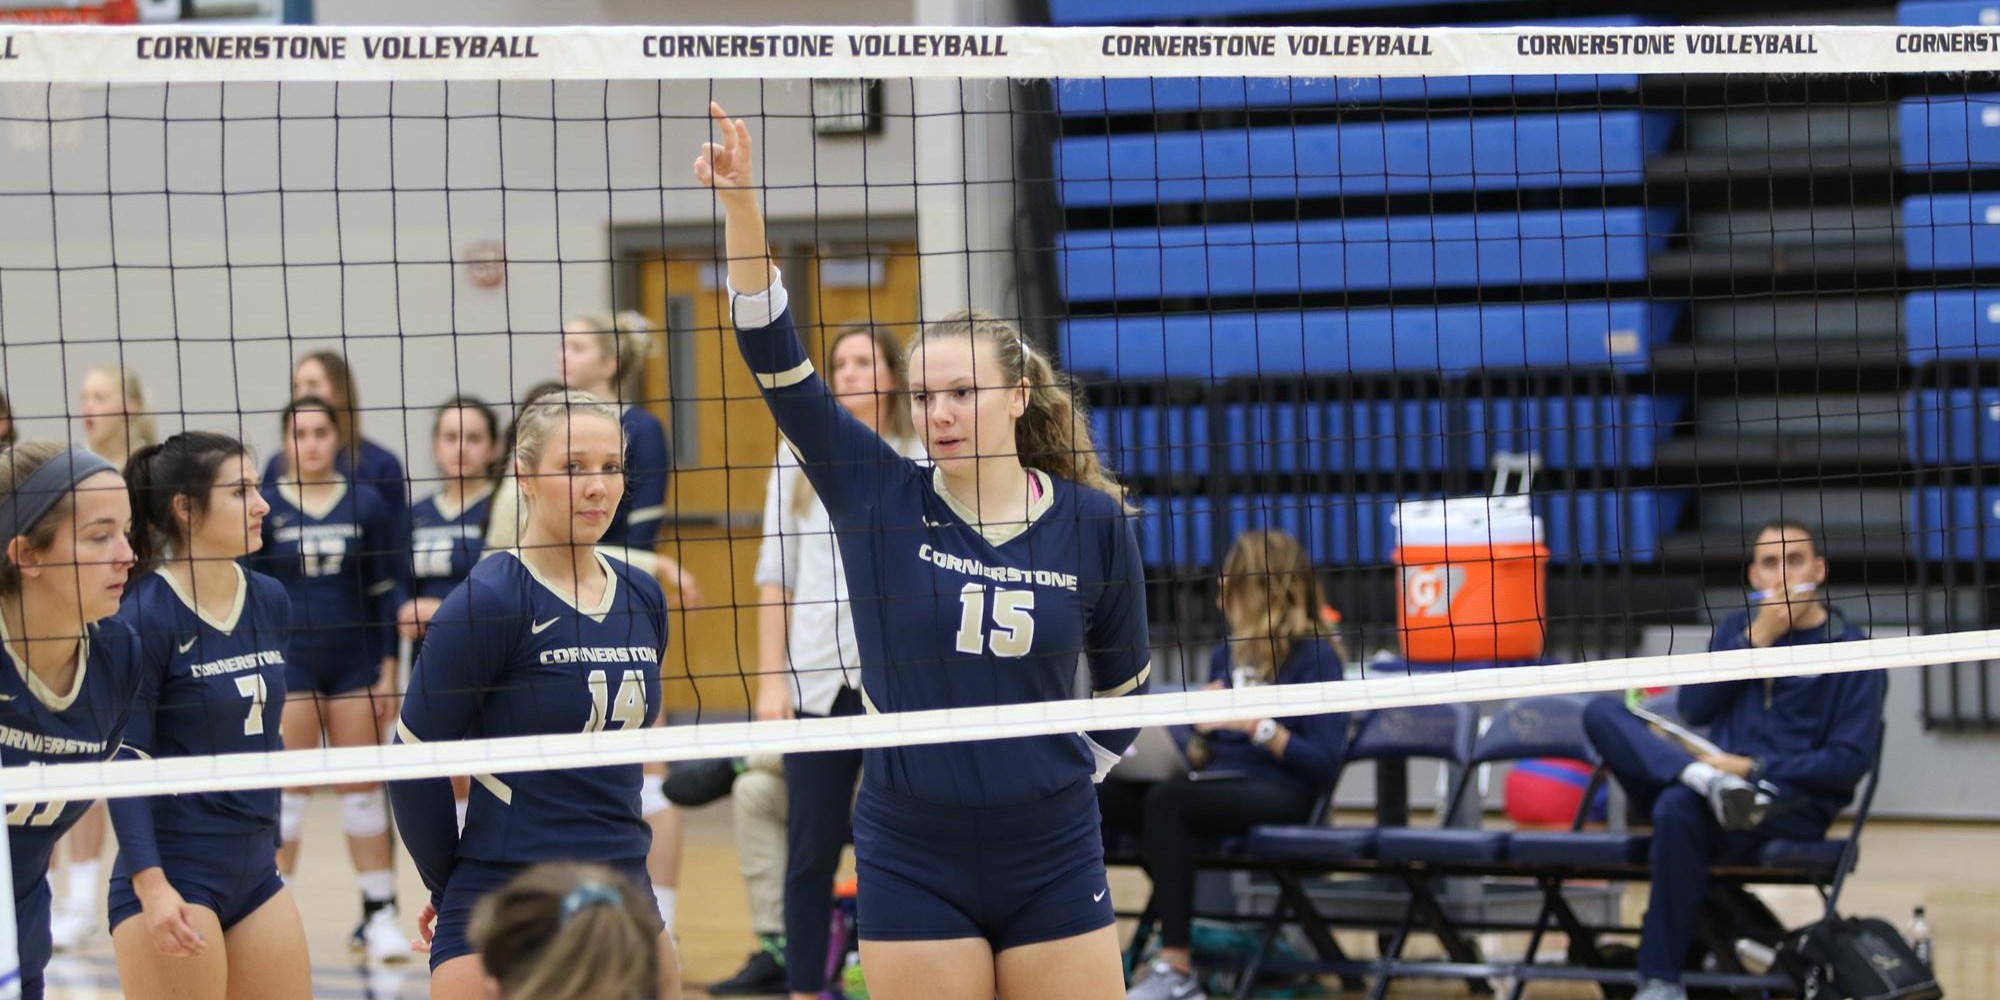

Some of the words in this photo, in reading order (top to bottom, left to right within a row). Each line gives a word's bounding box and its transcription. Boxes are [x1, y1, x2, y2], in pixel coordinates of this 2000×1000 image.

[136, 36, 347, 60] CORNERSTONE
[362, 35, 539, 60] VOLLEYBALL
[642, 35, 834, 58] CORNERSTONE
[848, 34, 1008, 57] VOLLEYBALL
[1101, 34, 1276, 57] CORNERSTONE
[1287, 34, 1433, 56] VOLLEYBALL
[1516, 34, 1675, 56] CORNERSTONE
[1684, 34, 1818, 55] VOLLEYBALL
[1895, 32, 2000, 54] CORNERST
[918, 543, 1078, 592] CORNERSTONE
[956, 582, 1035, 657] 15
[233, 673, 268, 736] 7
[581, 669, 648, 734] 14
